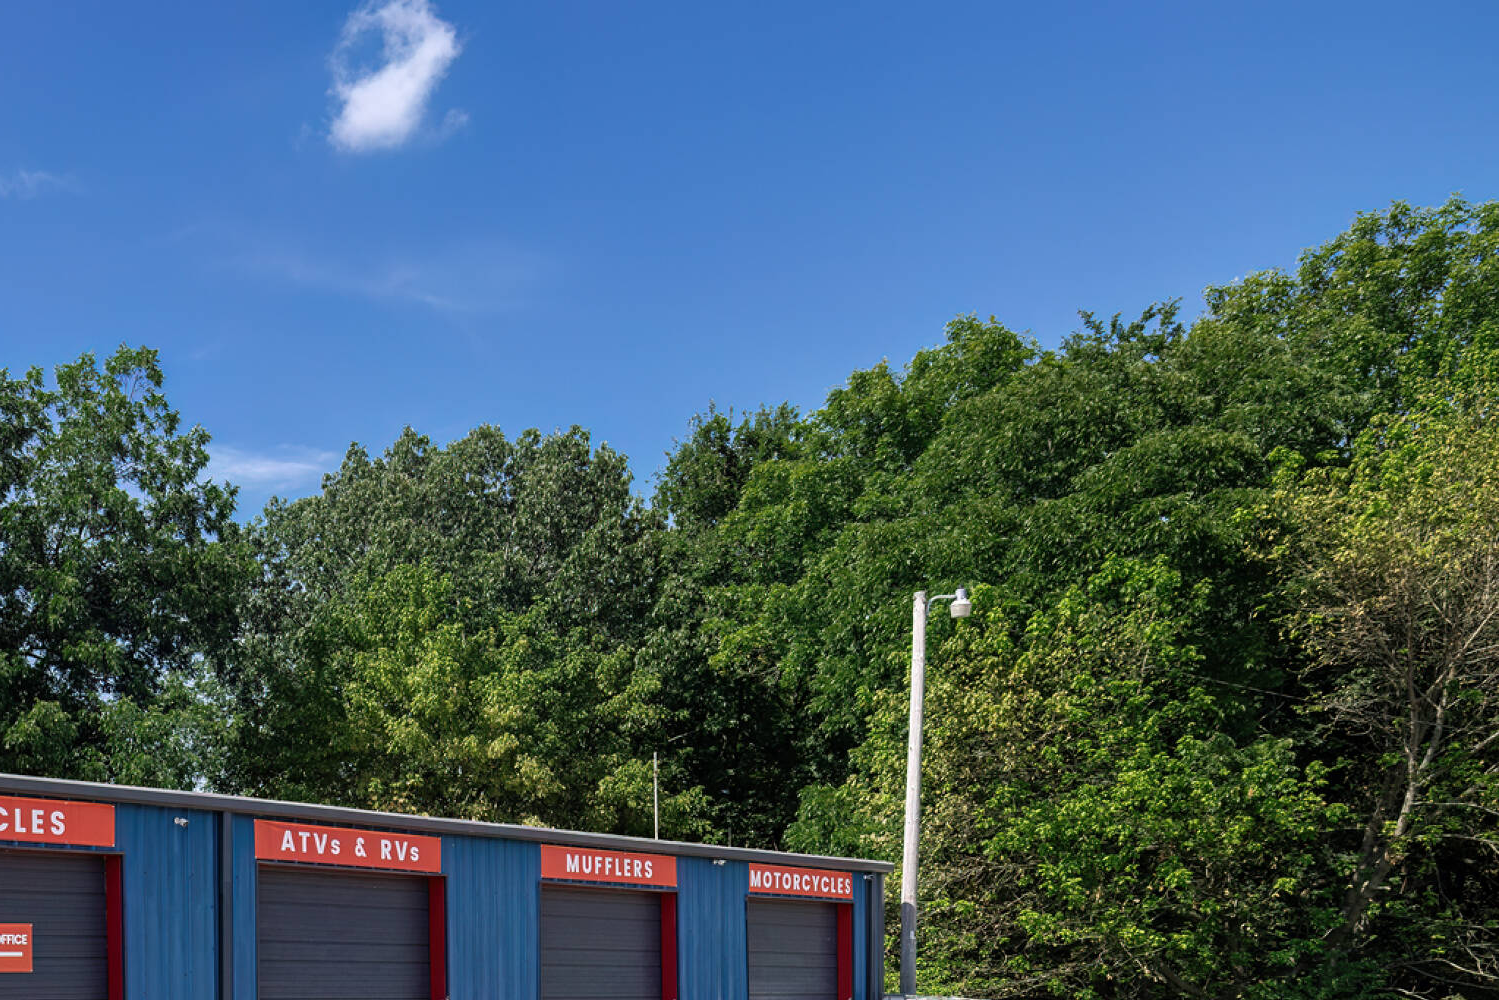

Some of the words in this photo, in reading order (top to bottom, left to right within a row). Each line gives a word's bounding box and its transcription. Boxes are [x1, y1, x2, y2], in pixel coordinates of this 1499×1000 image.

[281, 829, 341, 856] ATVs
[354, 837, 367, 857] &
[380, 838, 420, 862] RVs
[565, 852, 654, 879] MUFFLERS
[749, 869, 852, 896] MOTORCYCLES
